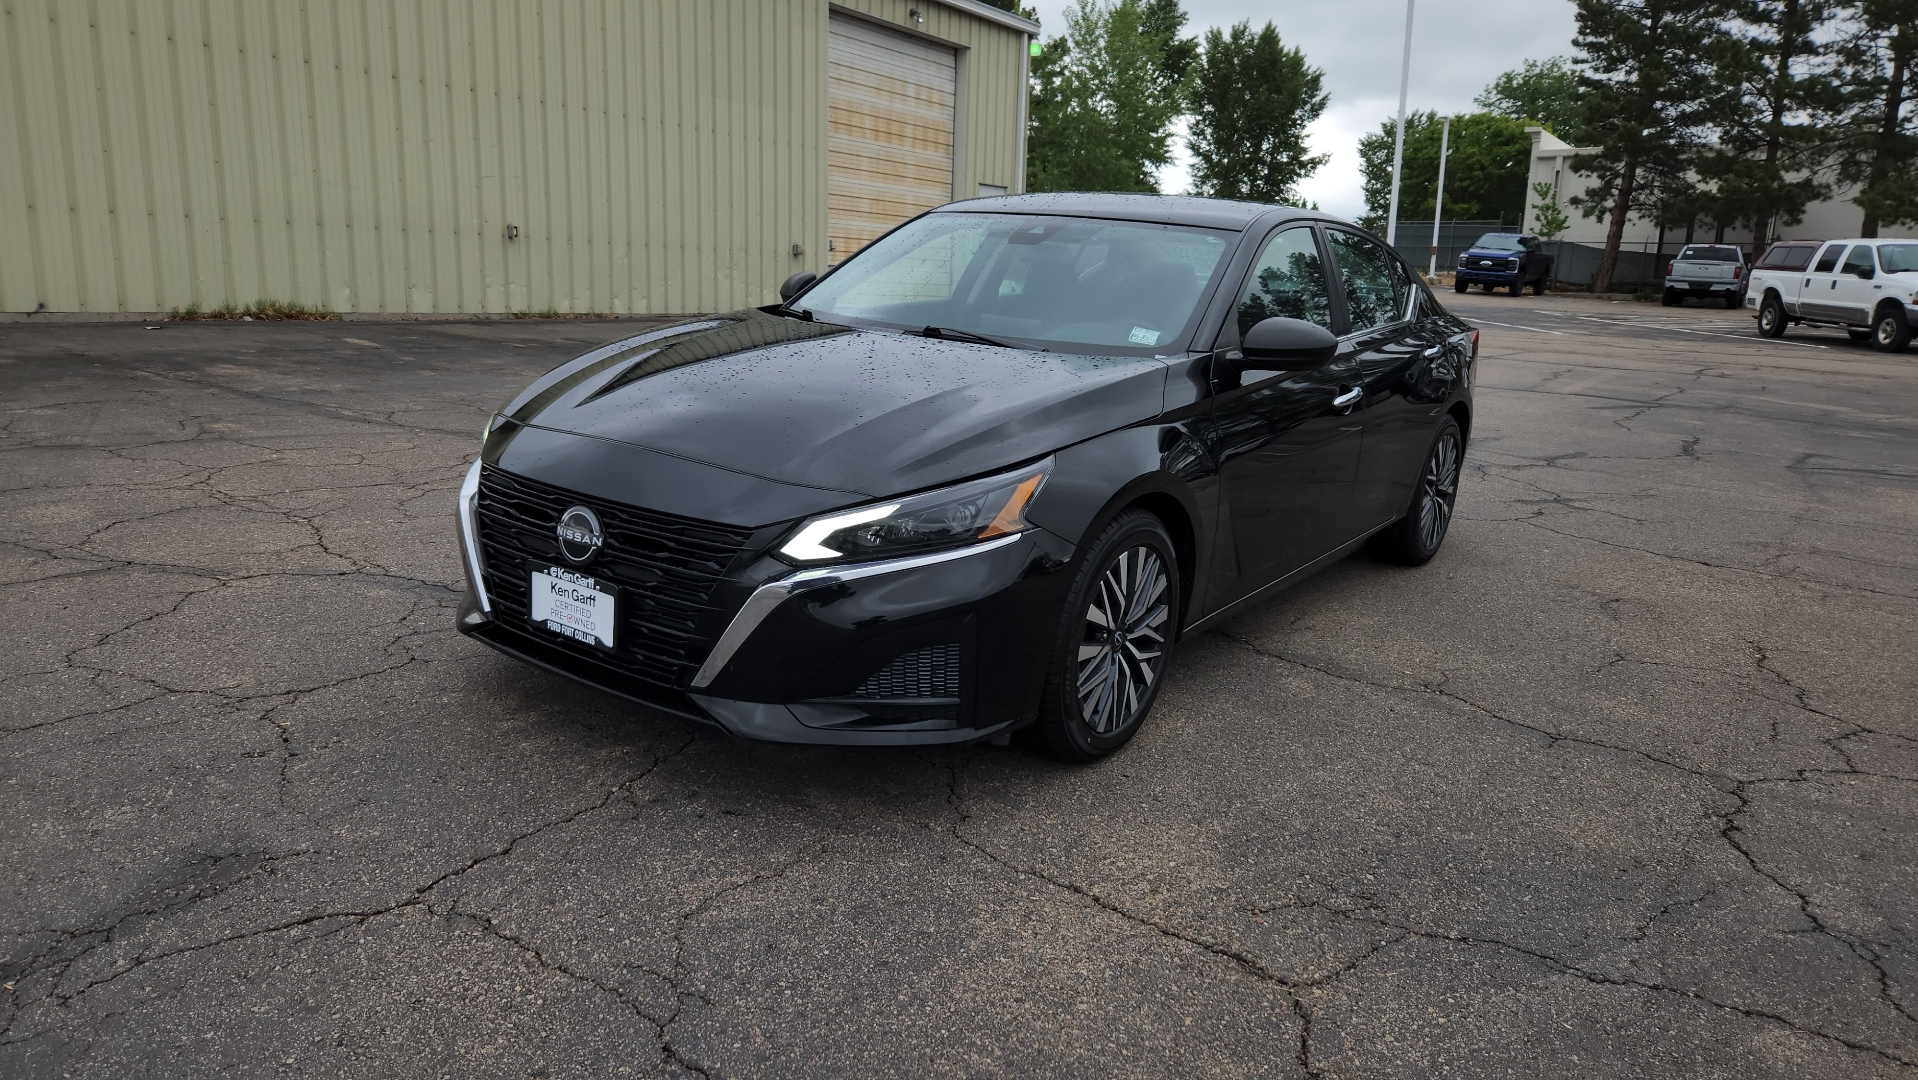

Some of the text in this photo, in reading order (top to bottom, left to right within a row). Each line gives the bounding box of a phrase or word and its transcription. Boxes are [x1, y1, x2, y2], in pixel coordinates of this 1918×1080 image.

[557, 524, 602, 546] NISSAN
[550, 581, 597, 608] Ken Garff
[555, 599, 592, 618] CERTIFIED
[547, 620, 596, 646] FORD FORT COLLINS
